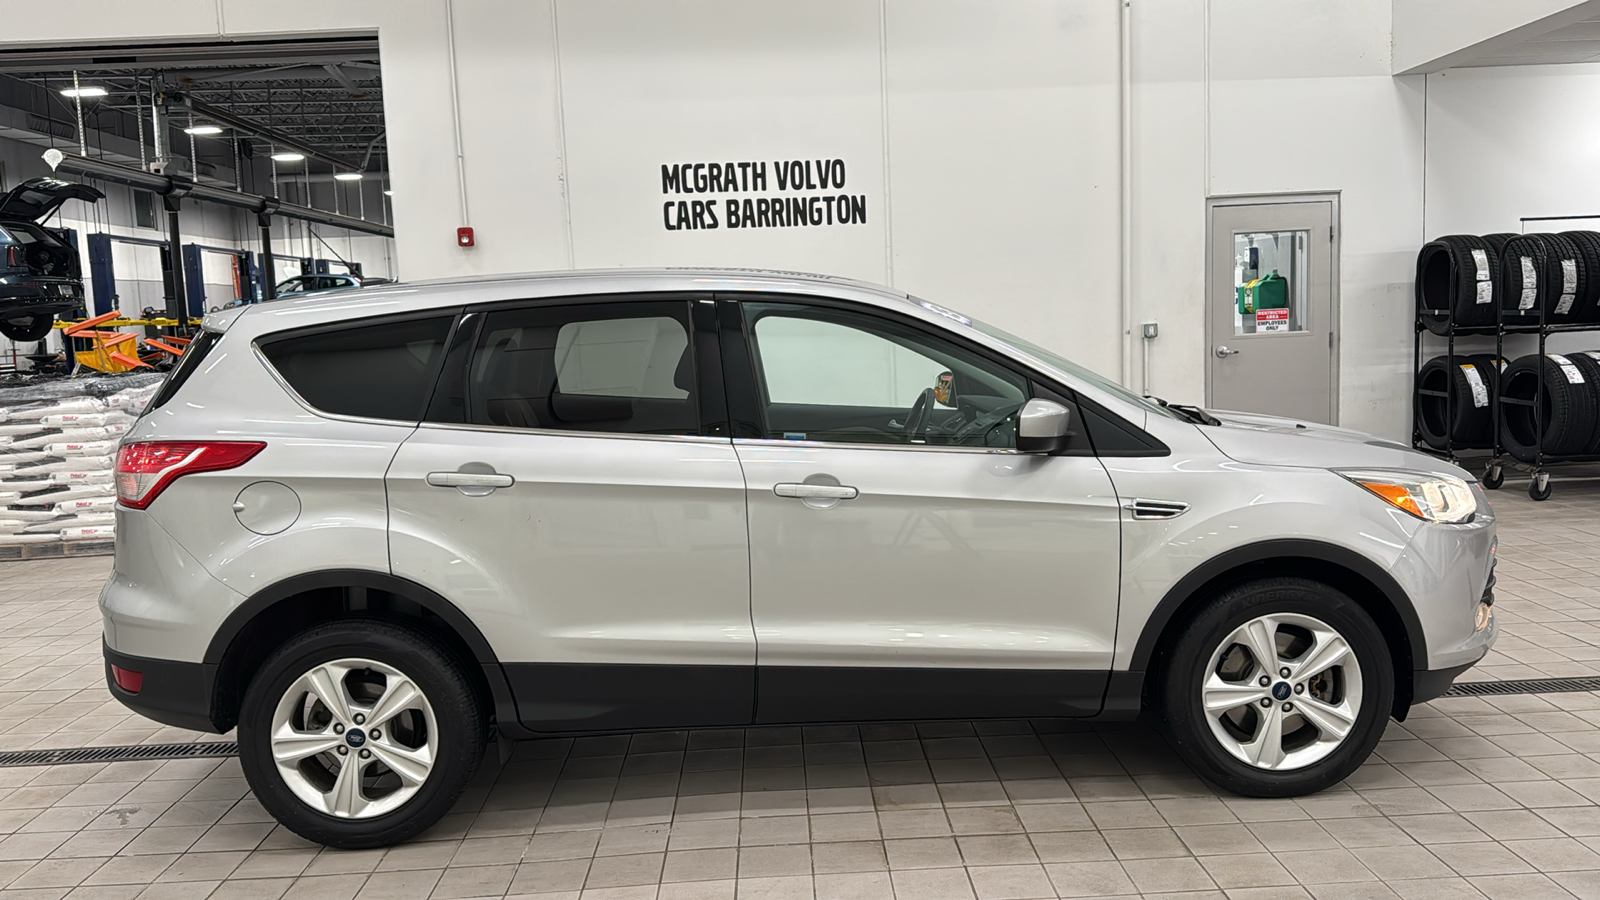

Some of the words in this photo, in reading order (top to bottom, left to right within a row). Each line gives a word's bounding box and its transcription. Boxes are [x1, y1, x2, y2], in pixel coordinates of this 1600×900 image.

[662, 162, 766, 193] MCGRATH
[774, 159, 845, 190] VOLVO
[664, 200, 718, 230] CARS
[726, 195, 866, 228] BARRINGTON
